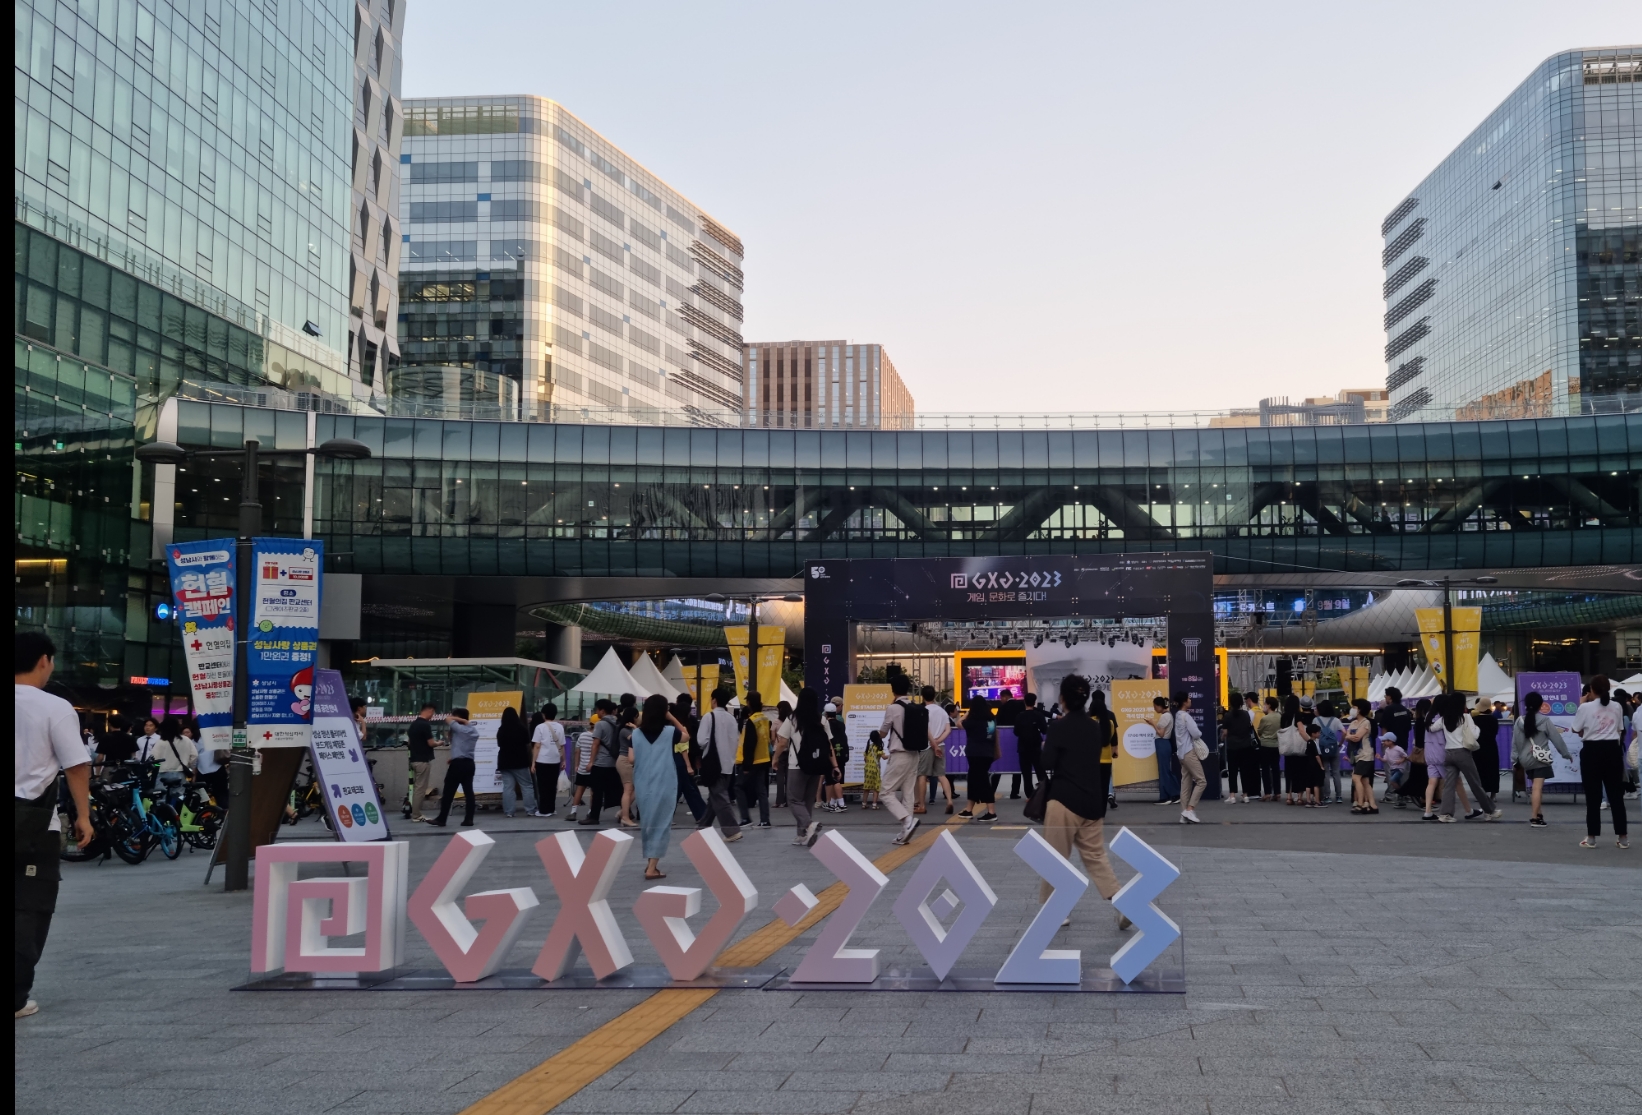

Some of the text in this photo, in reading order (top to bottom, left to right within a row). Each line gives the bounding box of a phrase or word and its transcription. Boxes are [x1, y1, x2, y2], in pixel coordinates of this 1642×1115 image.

[181, 572, 228, 598] 헌혈
[966, 591, 1047, 603] 게임, 문화로 즐기다!
[184, 598, 231, 617] 캠페인
[206, 640, 231, 650] 헌혈의집
[254, 640, 317, 650] 성남사랑 상품권
[261, 651, 311, 662] 1만원권 증정!
[198, 661, 230, 670] 판교센터에서
[192, 672, 216, 680] 헌혈하신
